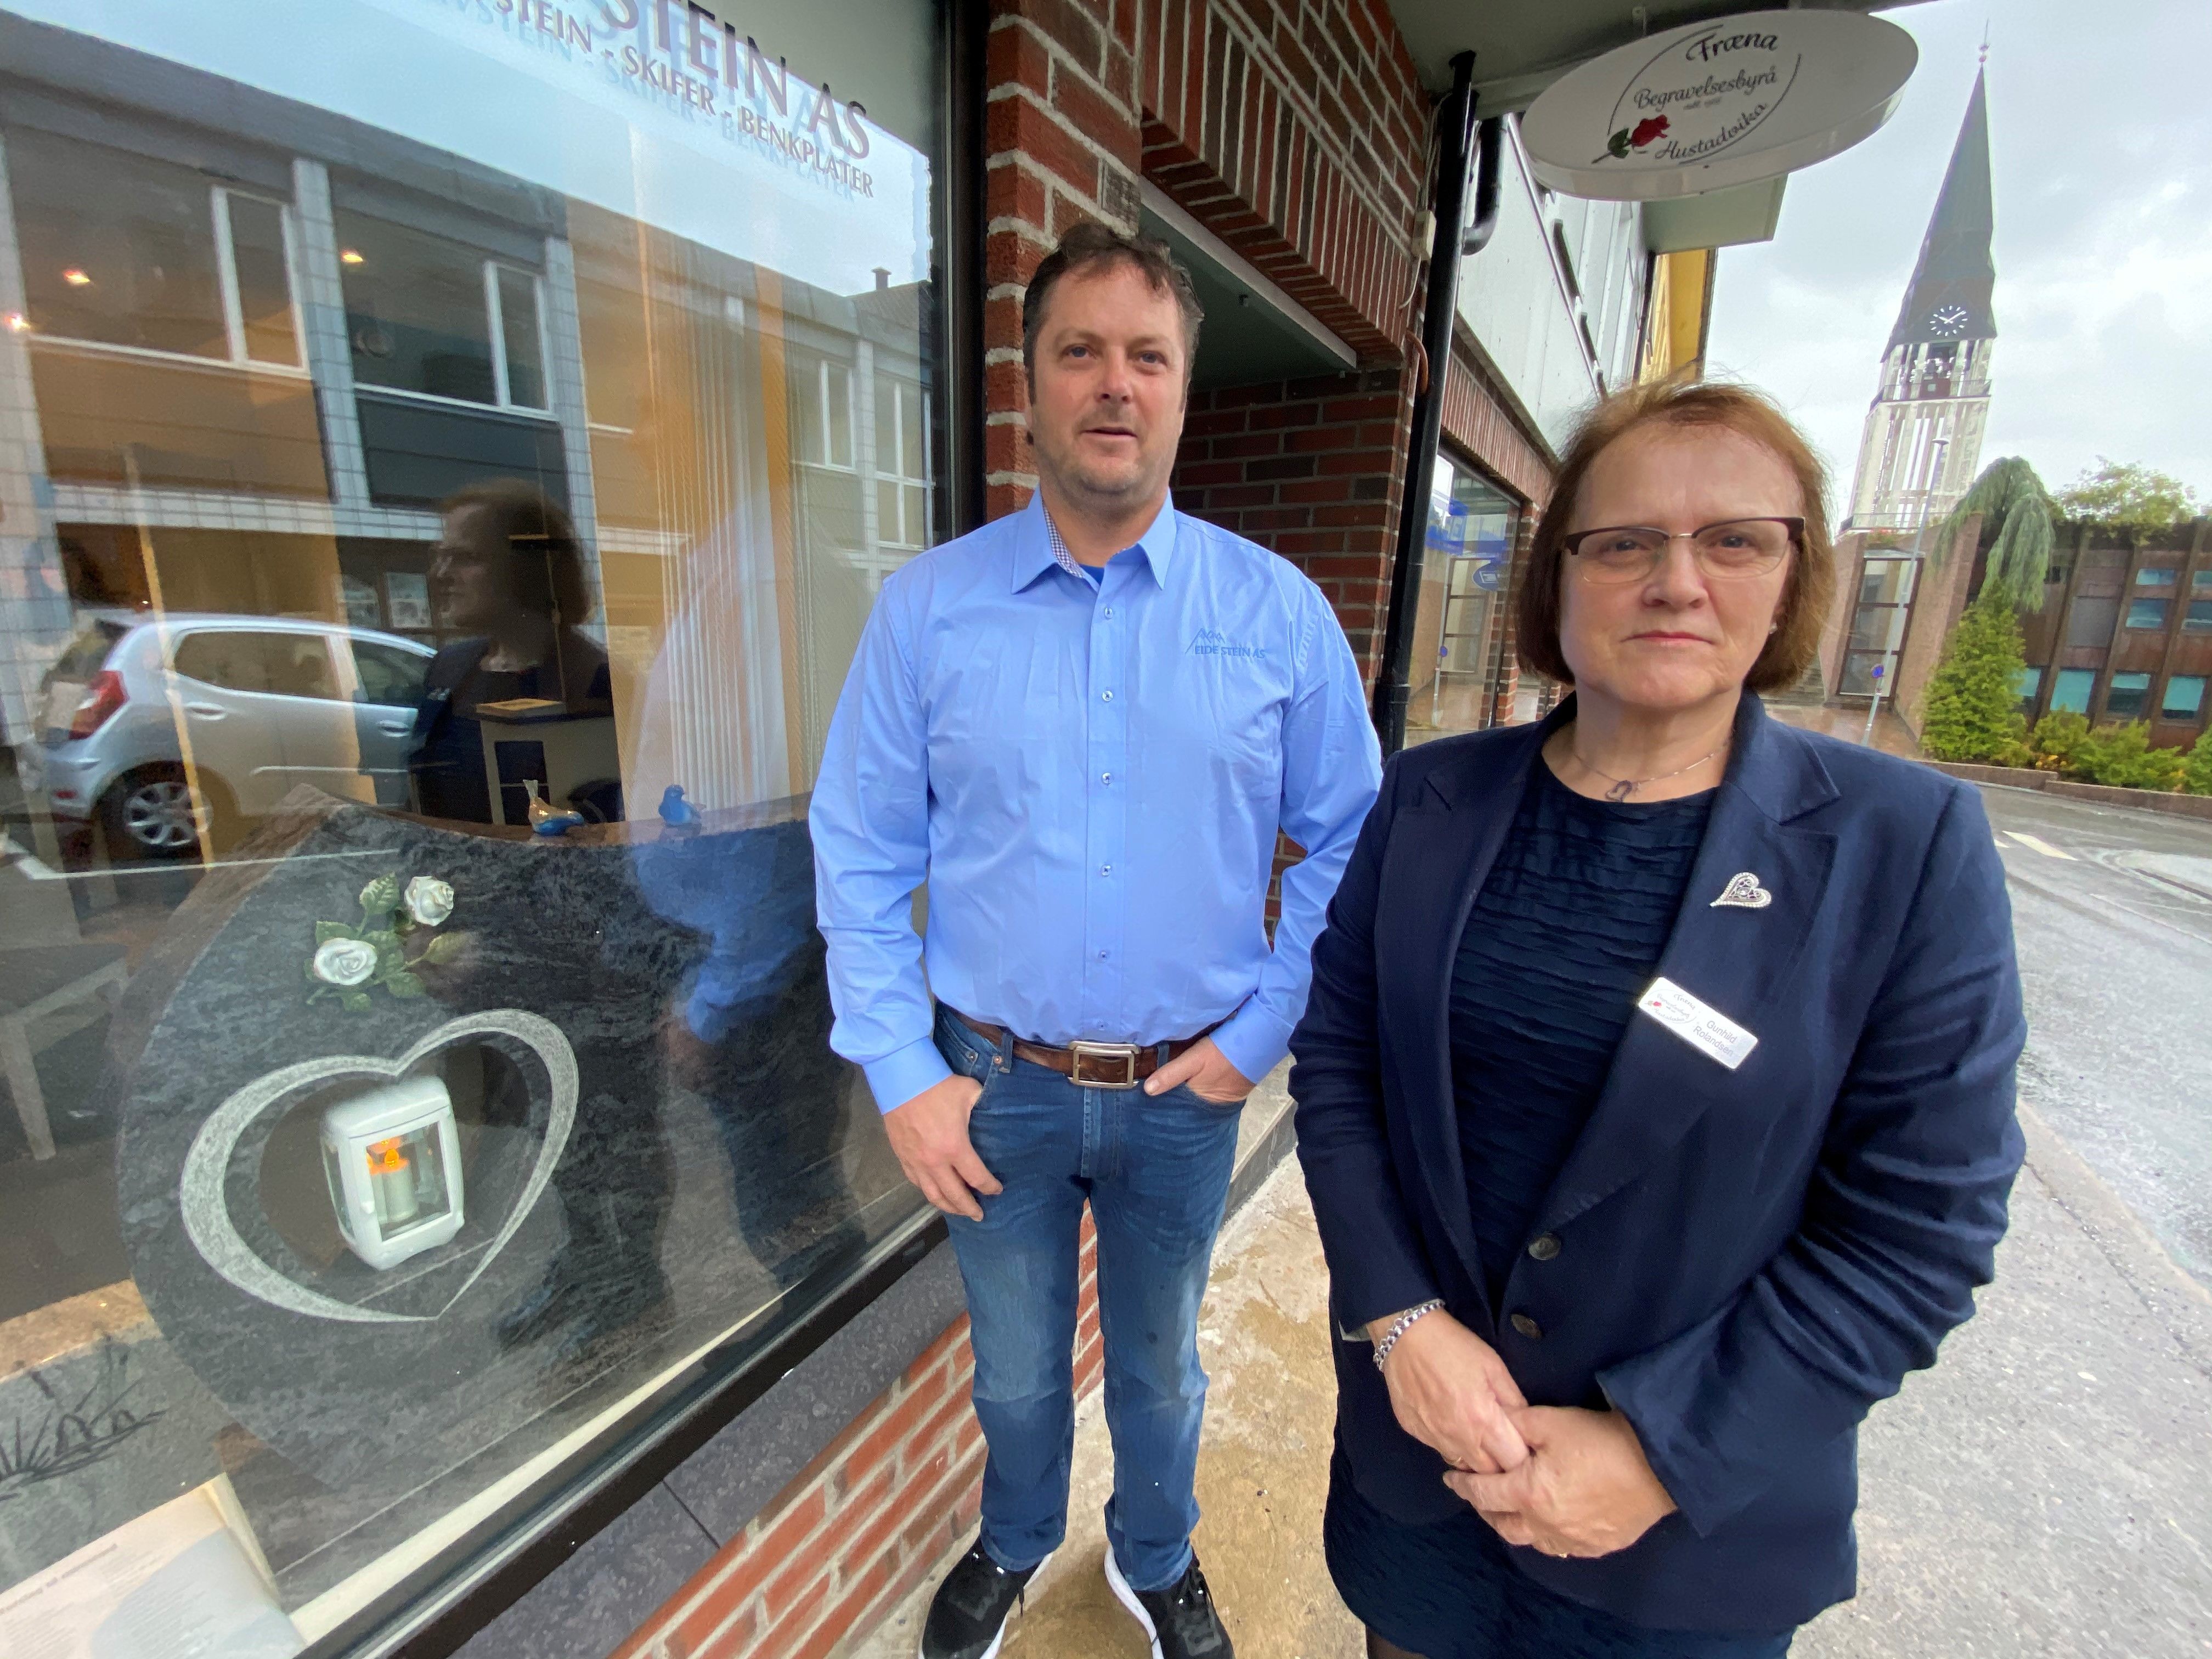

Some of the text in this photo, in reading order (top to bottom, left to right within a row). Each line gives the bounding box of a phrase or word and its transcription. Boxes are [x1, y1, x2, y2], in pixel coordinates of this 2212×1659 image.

[1685, 33, 1779, 62] Fræna
[1633, 65, 1778, 112] Begravelsesbyrå
[621, 45, 715, 116] SKIFER
[737, 105, 874, 198] BENKPLATER
[808, 82, 870, 159] AS
[1654, 103, 1769, 161] Hustadvika
[1195, 645, 1266, 659] EIDE STEIN AS
[1693, 1025, 1735, 1057] Rolandsen
[1706, 1020, 1738, 1043] Gunhild
